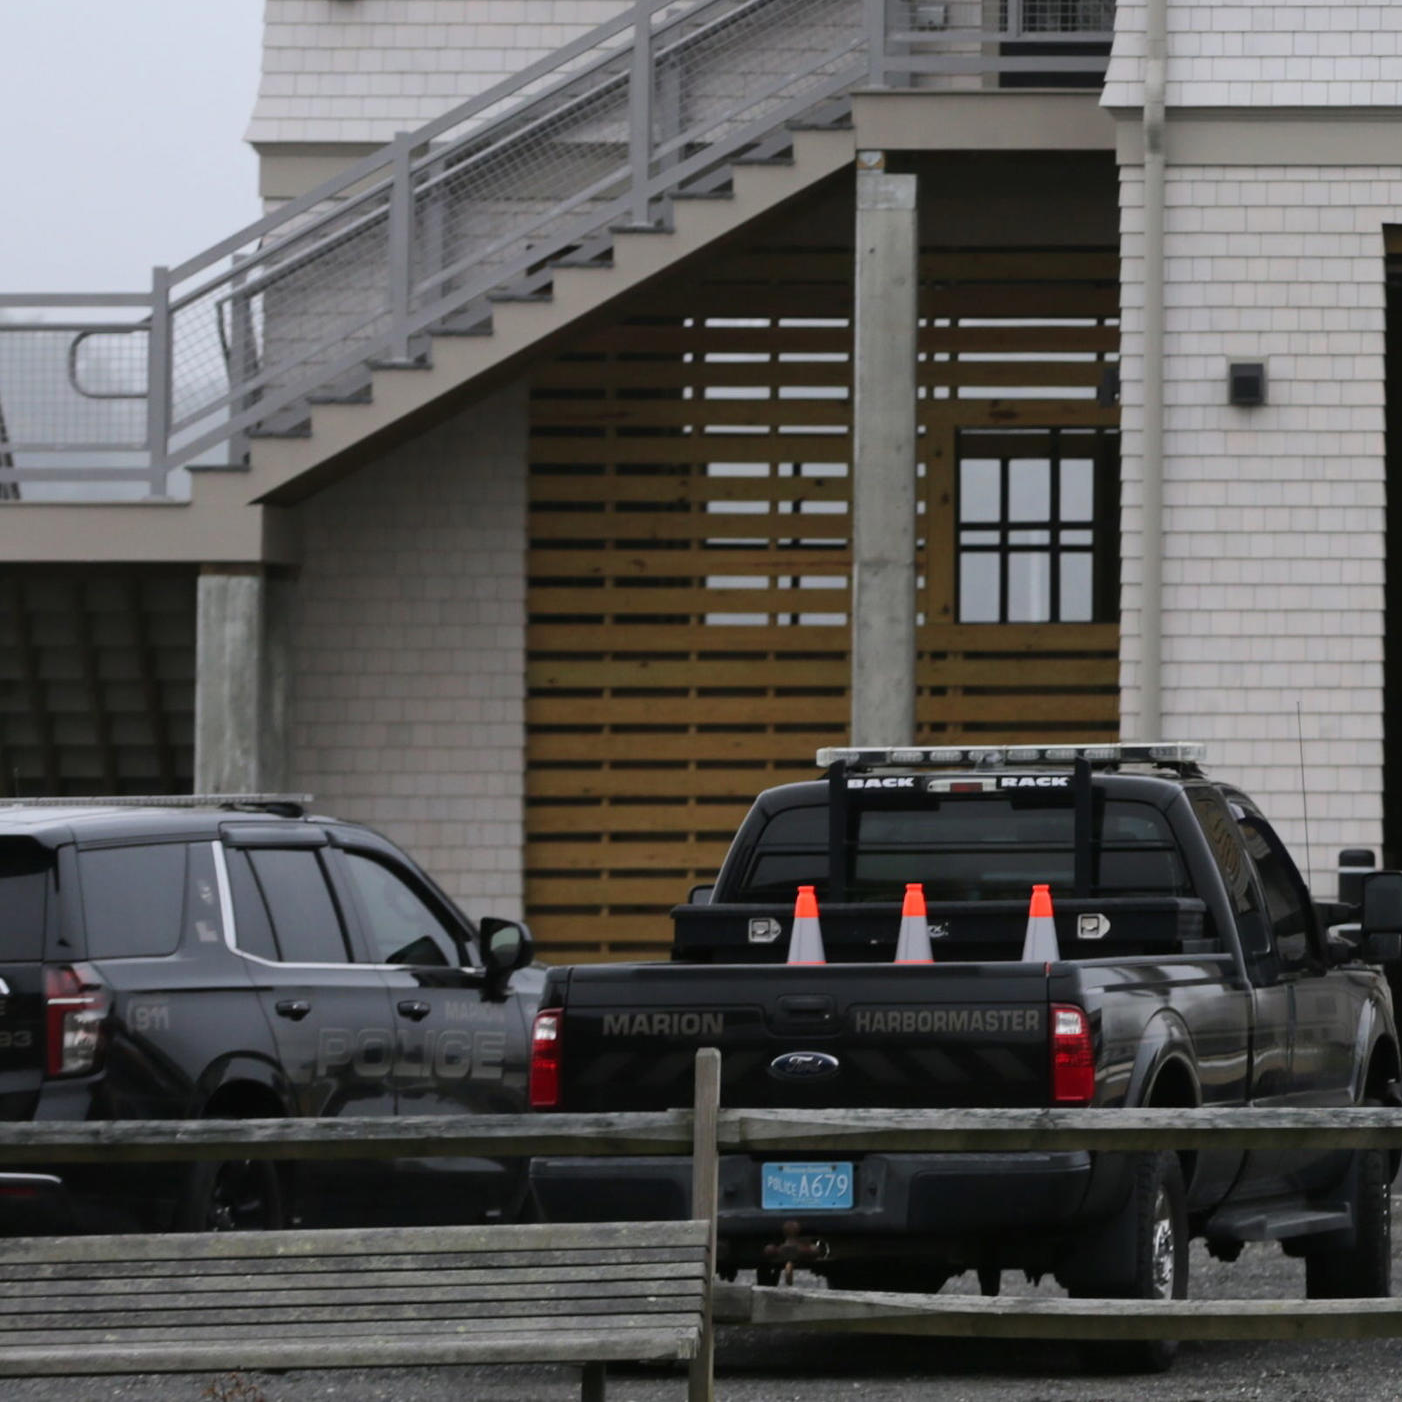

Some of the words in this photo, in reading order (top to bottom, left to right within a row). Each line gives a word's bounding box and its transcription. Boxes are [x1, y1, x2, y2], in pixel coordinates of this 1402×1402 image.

[846, 777, 914, 790] BACK
[1001, 776, 1068, 788] RACK
[603, 1012, 725, 1037] MARION
[854, 1010, 1040, 1034] HARBORMASTER
[316, 1027, 507, 1080] POLICE
[798, 1173, 848, 1198] A679
